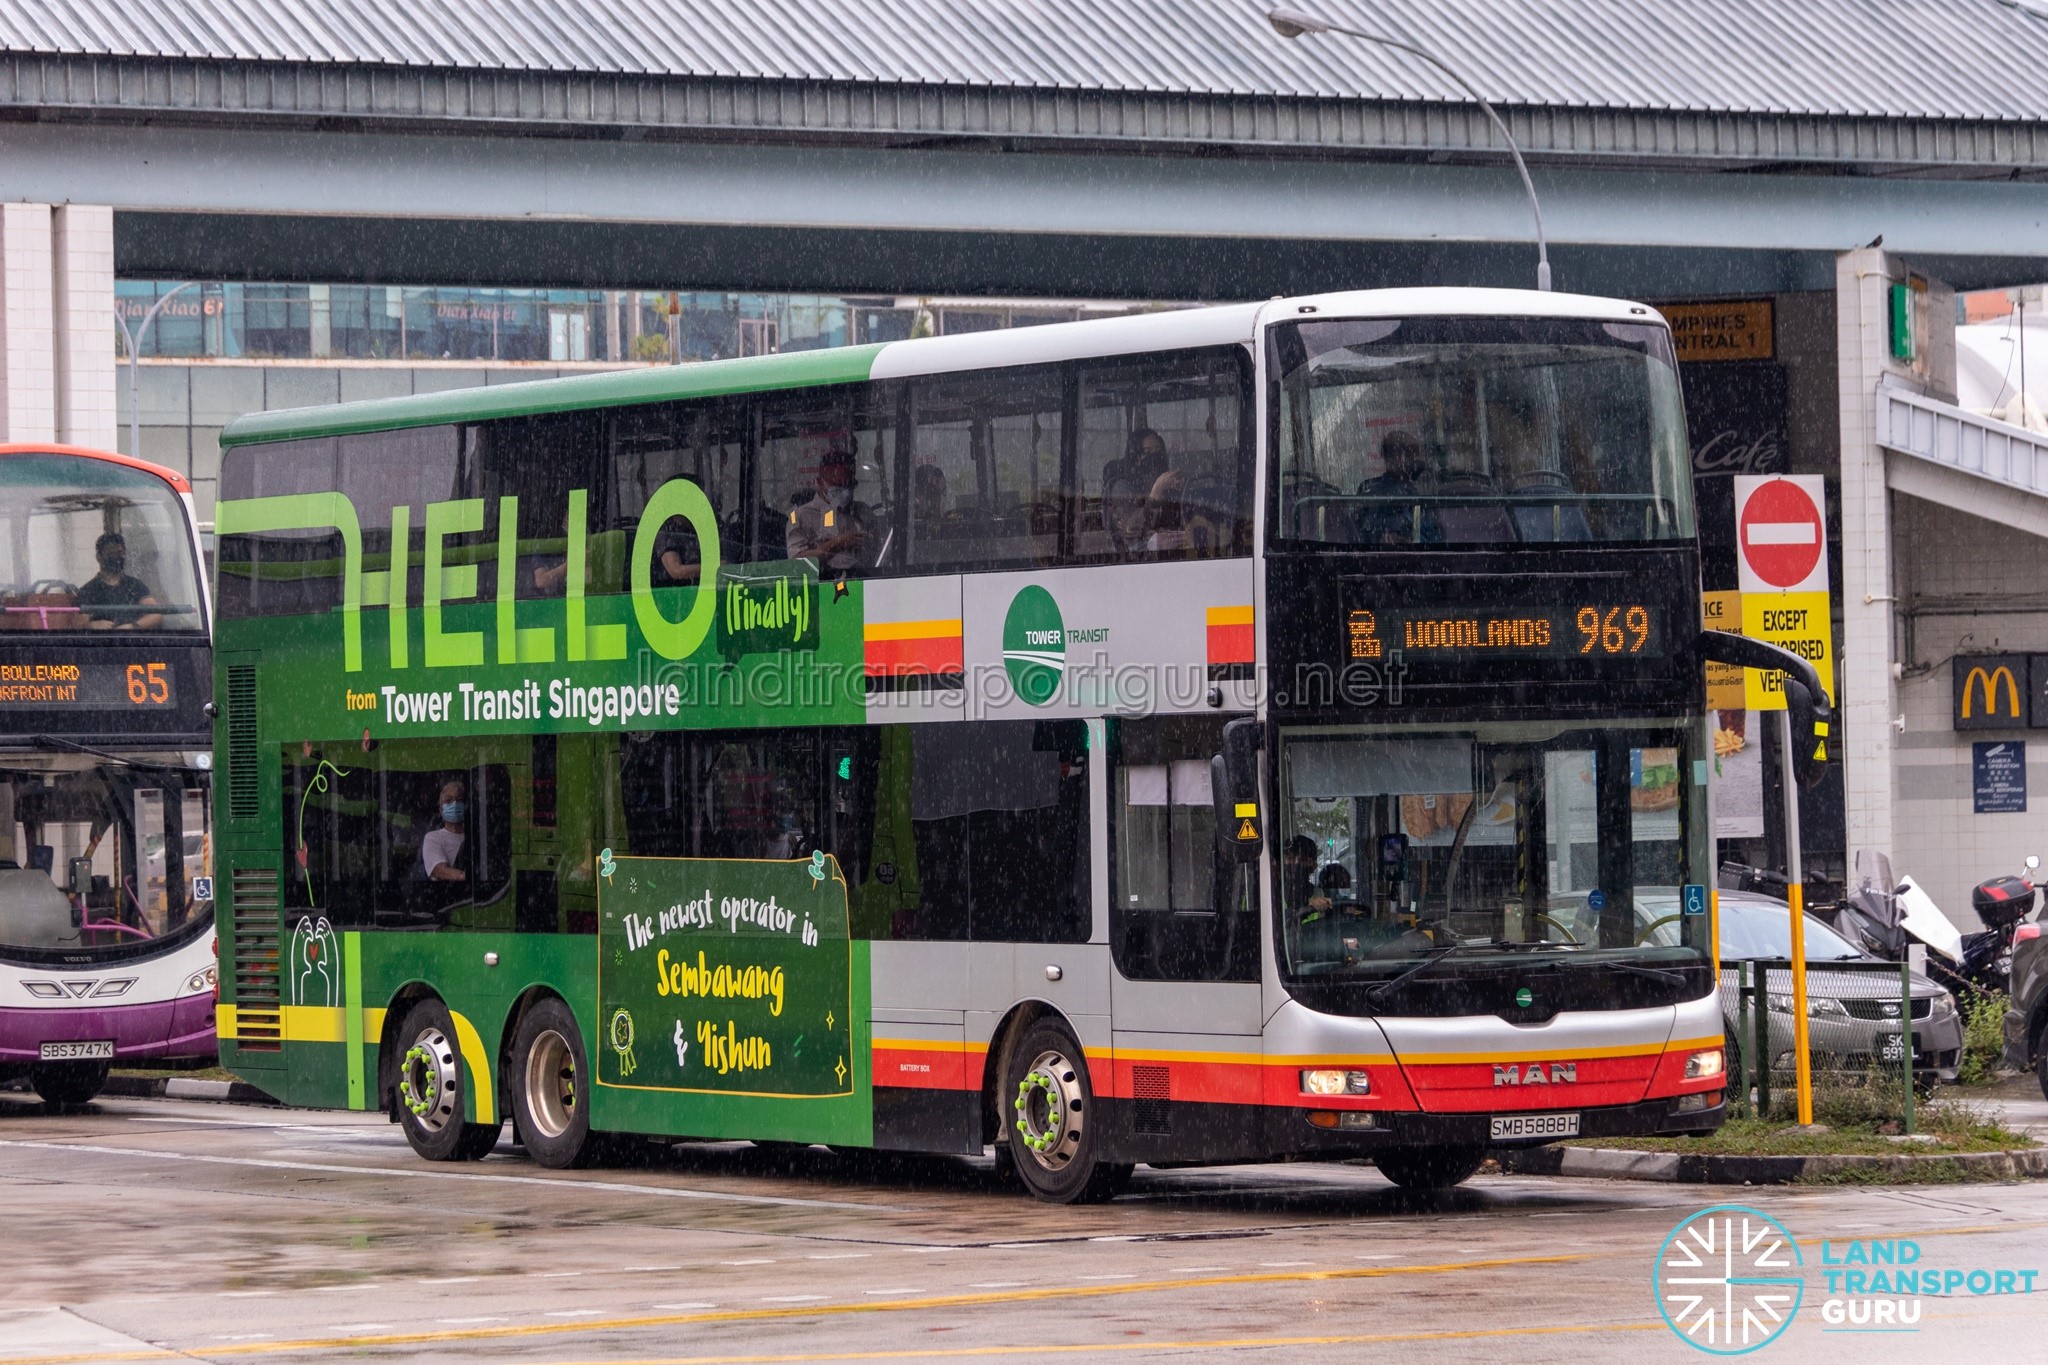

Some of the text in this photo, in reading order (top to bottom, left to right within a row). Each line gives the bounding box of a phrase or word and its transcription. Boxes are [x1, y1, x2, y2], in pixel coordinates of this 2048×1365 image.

[1672, 314, 1747, 331] MPINES
[1675, 332, 1757, 350] NTRAL 1
[1695, 430, 1777, 472] Café
[216, 478, 721, 672] HELLO
[1704, 601, 1723, 616] ICE
[1406, 606, 1649, 654] WOODLANDS 969
[1763, 609, 1808, 631] EXCEPT
[1025, 628, 1110, 645] TOWER TRANSIT
[1767, 640, 1824, 660] ORISED
[1, 665, 80, 681] BOULEVARD
[125, 662, 169, 704] 65
[0, 686, 76, 701] RFRONT INT
[346, 678, 680, 725] from Tower Transit Singapore
[623, 889, 818, 951] The newest operator in
[64, 955, 92, 963] VOLVO
[657, 949, 784, 1017] Sembawang
[697, 1020, 771, 1075] Yishun
[1888, 1034, 1904, 1047] SK
[42, 1043, 112, 1059] SBS3747K
[1882, 1046, 1919, 1060] 591L
[900, 1064, 930, 1072] BATTERY BOX
[1493, 1063, 1577, 1087] MAN
[1491, 1116, 1579, 1136] SMB5888H
